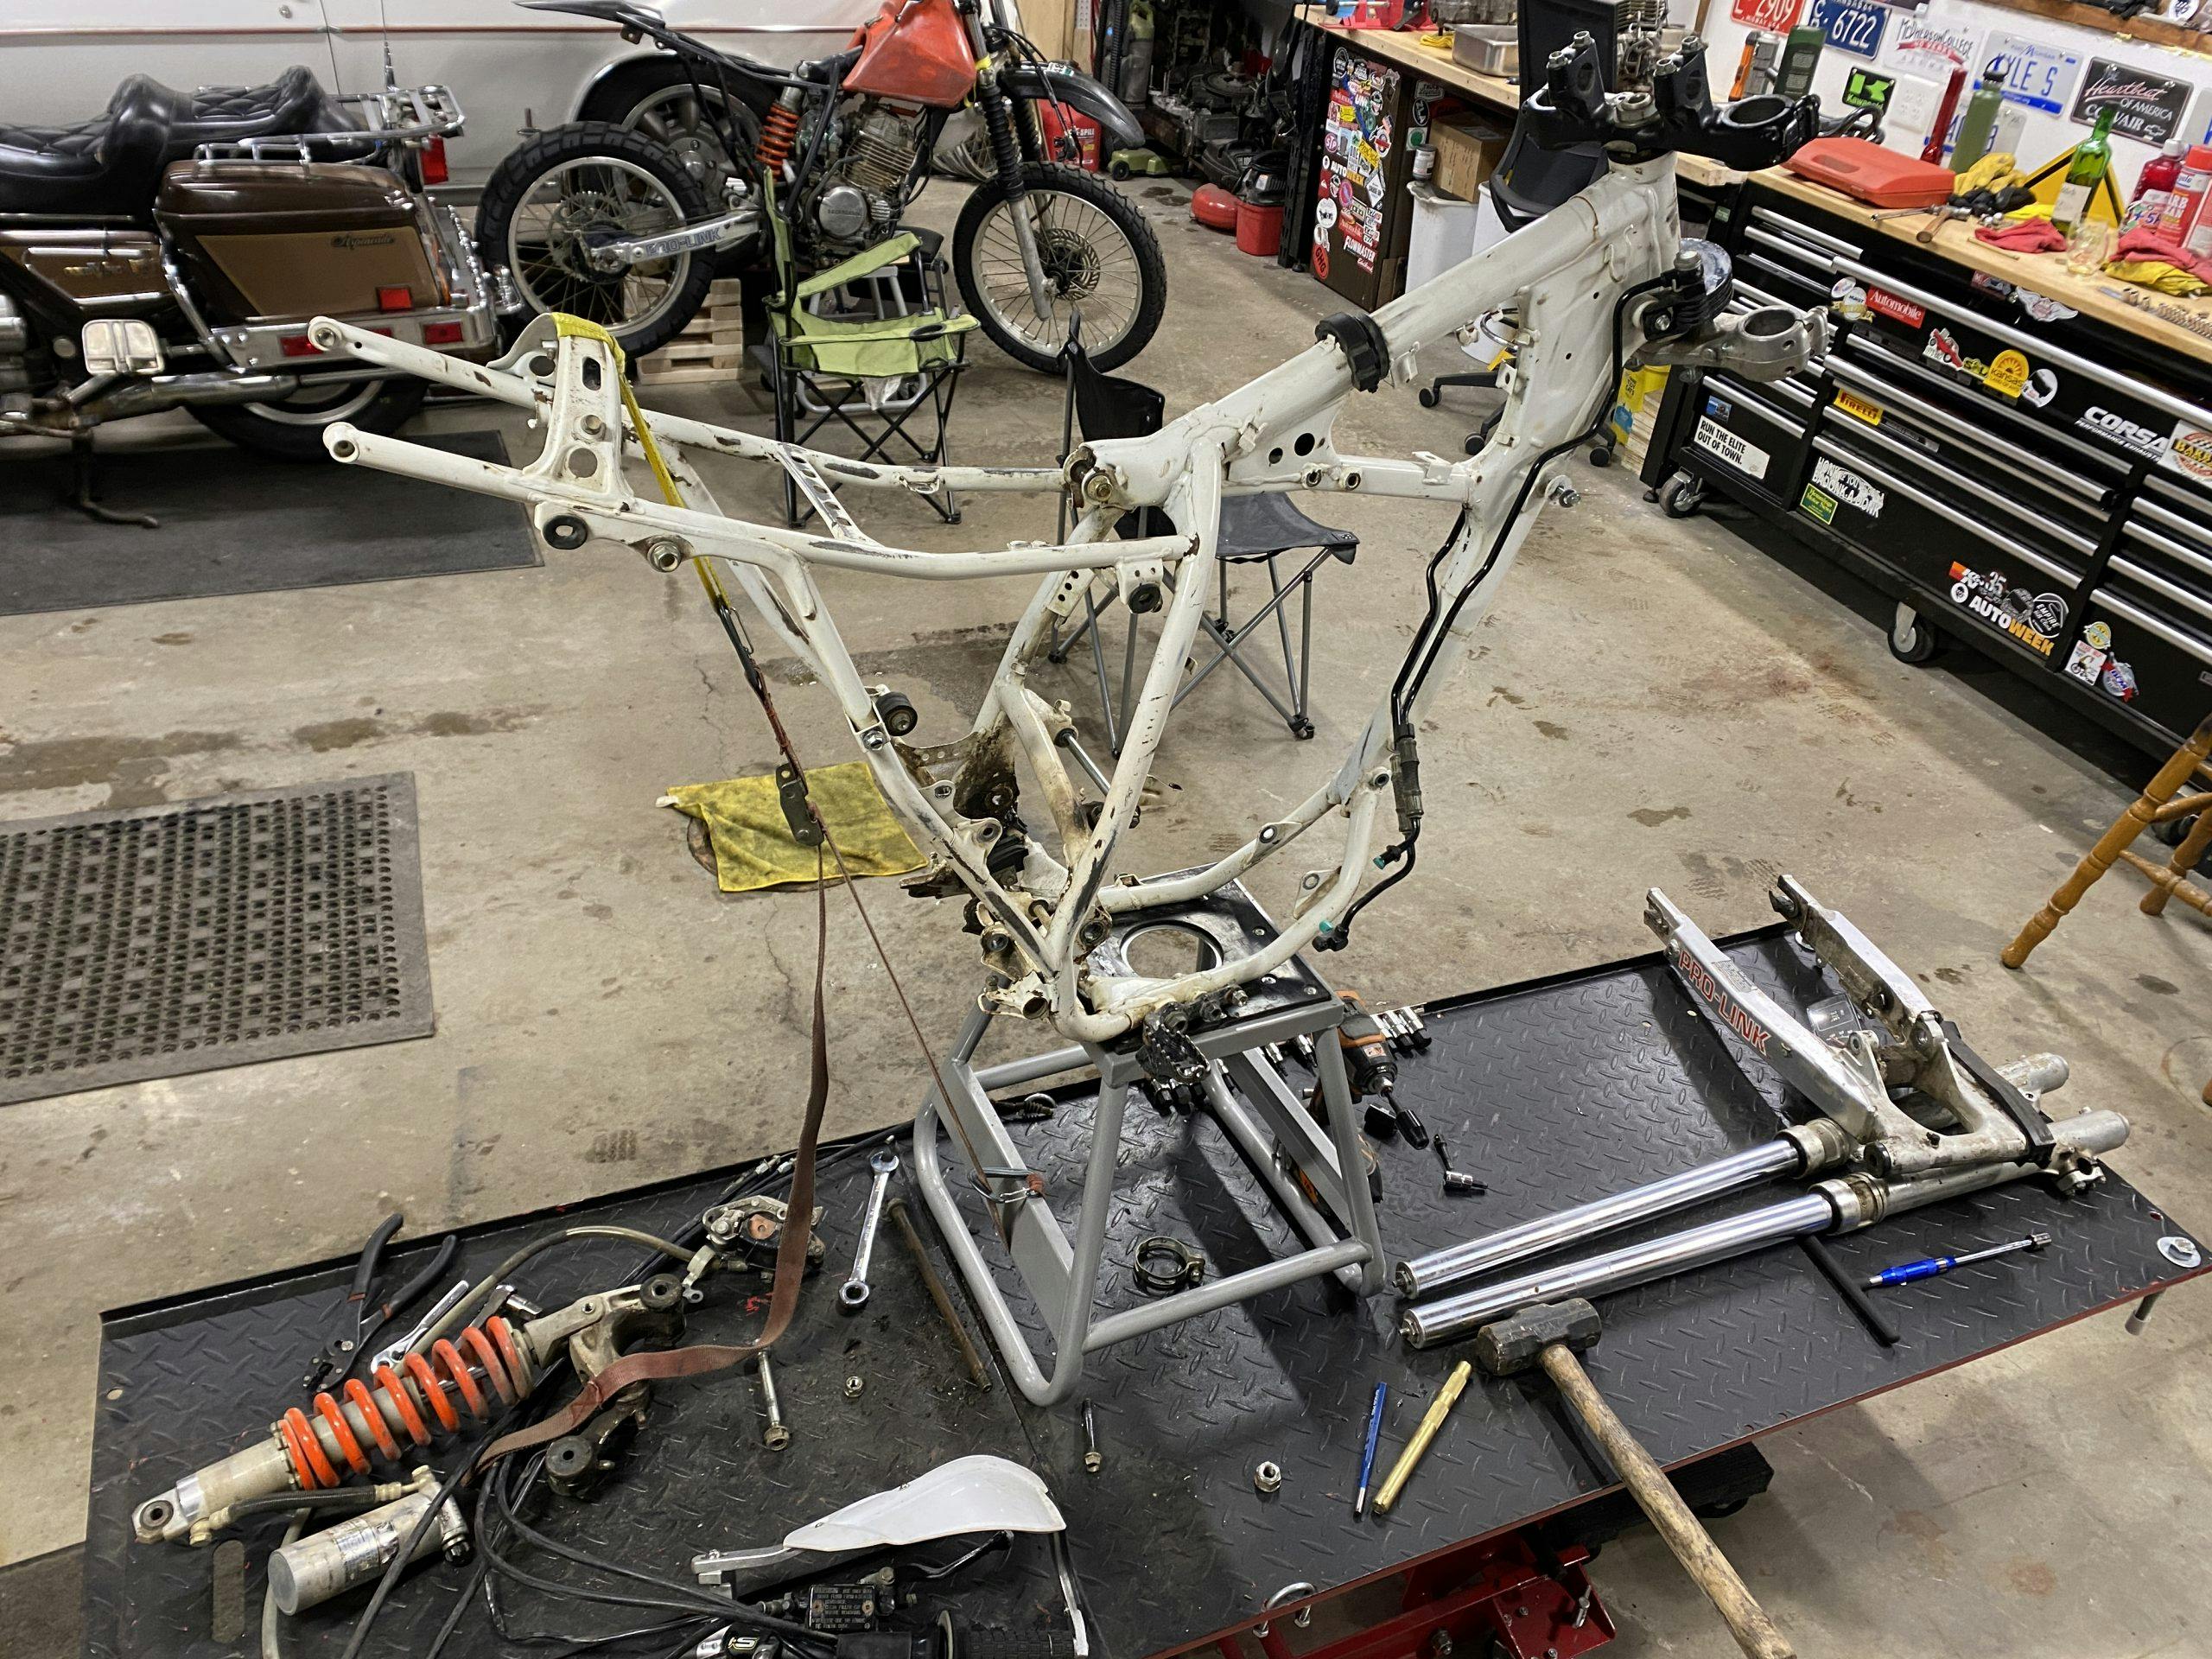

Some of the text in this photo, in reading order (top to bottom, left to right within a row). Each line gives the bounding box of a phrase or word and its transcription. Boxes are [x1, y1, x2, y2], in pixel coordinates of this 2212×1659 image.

[1755, 0, 1795, 24] 2909
[1831, 9, 1878, 49] 6722
[2041, 66, 2058, 97] S
[2083, 77, 2168, 101] Heartbeat
[2085, 103, 2145, 130] COVAIR
[2132, 101, 2174, 121] AMERICA
[1326, 134, 1338, 149] STP
[1331, 160, 1365, 186] AUTOWEEK
[645, 226, 721, 256] PRO-LINK
[1344, 235, 1376, 263] FLOWMASTER
[1315, 246, 1326, 273] GHG
[1869, 290, 1923, 321] Automobile
[1990, 367, 2025, 388] Kansas
[1840, 391, 1879, 420] PIRELLI
[1700, 420, 1746, 454] RUN THE ELITE
[2083, 405, 2171, 454] CORSA
[1698, 431, 1743, 465] OUT OF TOWN.
[1968, 594, 2056, 657] AUTOWEEK
[2036, 603, 2061, 630] EMPIRE
[1678, 950, 1772, 1057] PRO-LINK
